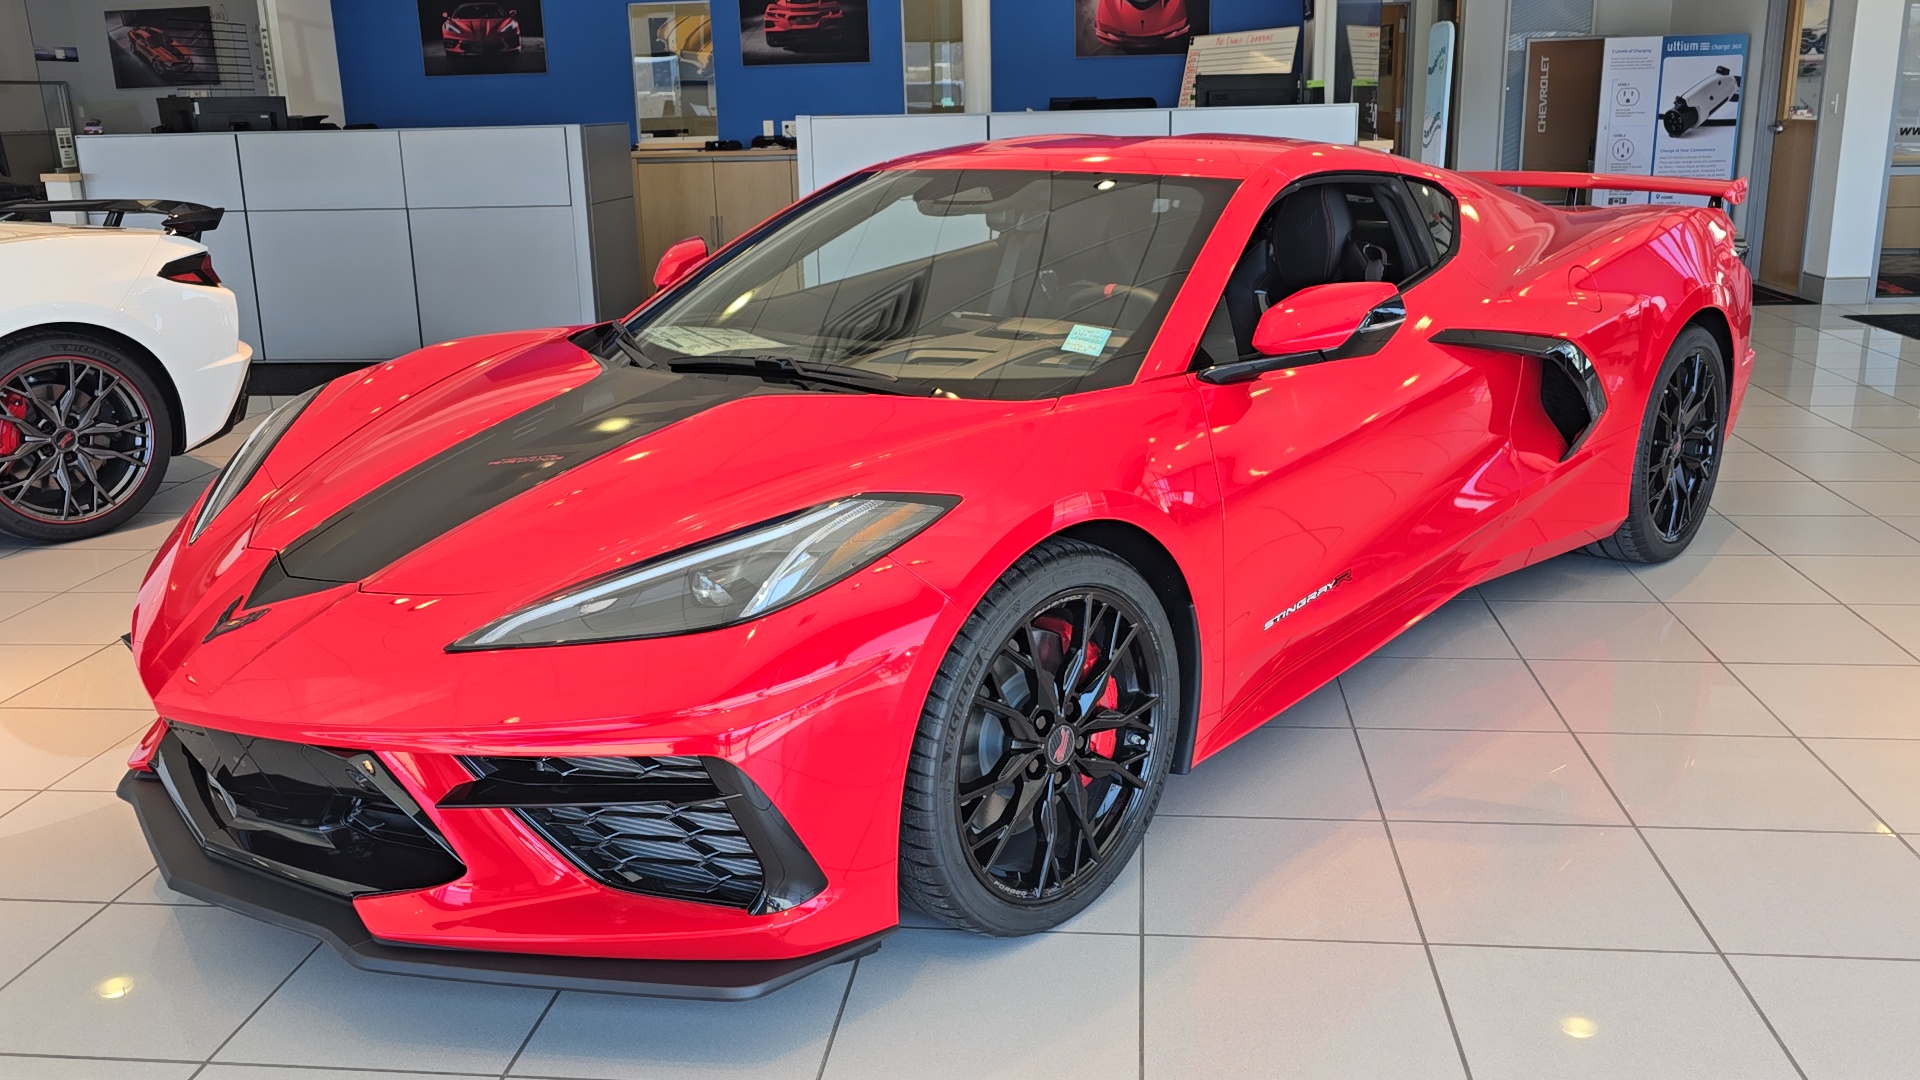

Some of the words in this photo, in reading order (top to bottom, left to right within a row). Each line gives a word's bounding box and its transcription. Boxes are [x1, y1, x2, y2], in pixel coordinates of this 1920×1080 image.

[1666, 41, 1699, 52] ultium
[1711, 43, 1731, 51] charge
[1537, 54, 1550, 133] CHEVROLET
[67, 344, 119, 362] MICHELIN
[1263, 579, 1337, 631] STINGRAY
[944, 652, 983, 753] MICHELIN
[993, 880, 1028, 897] FORGED
